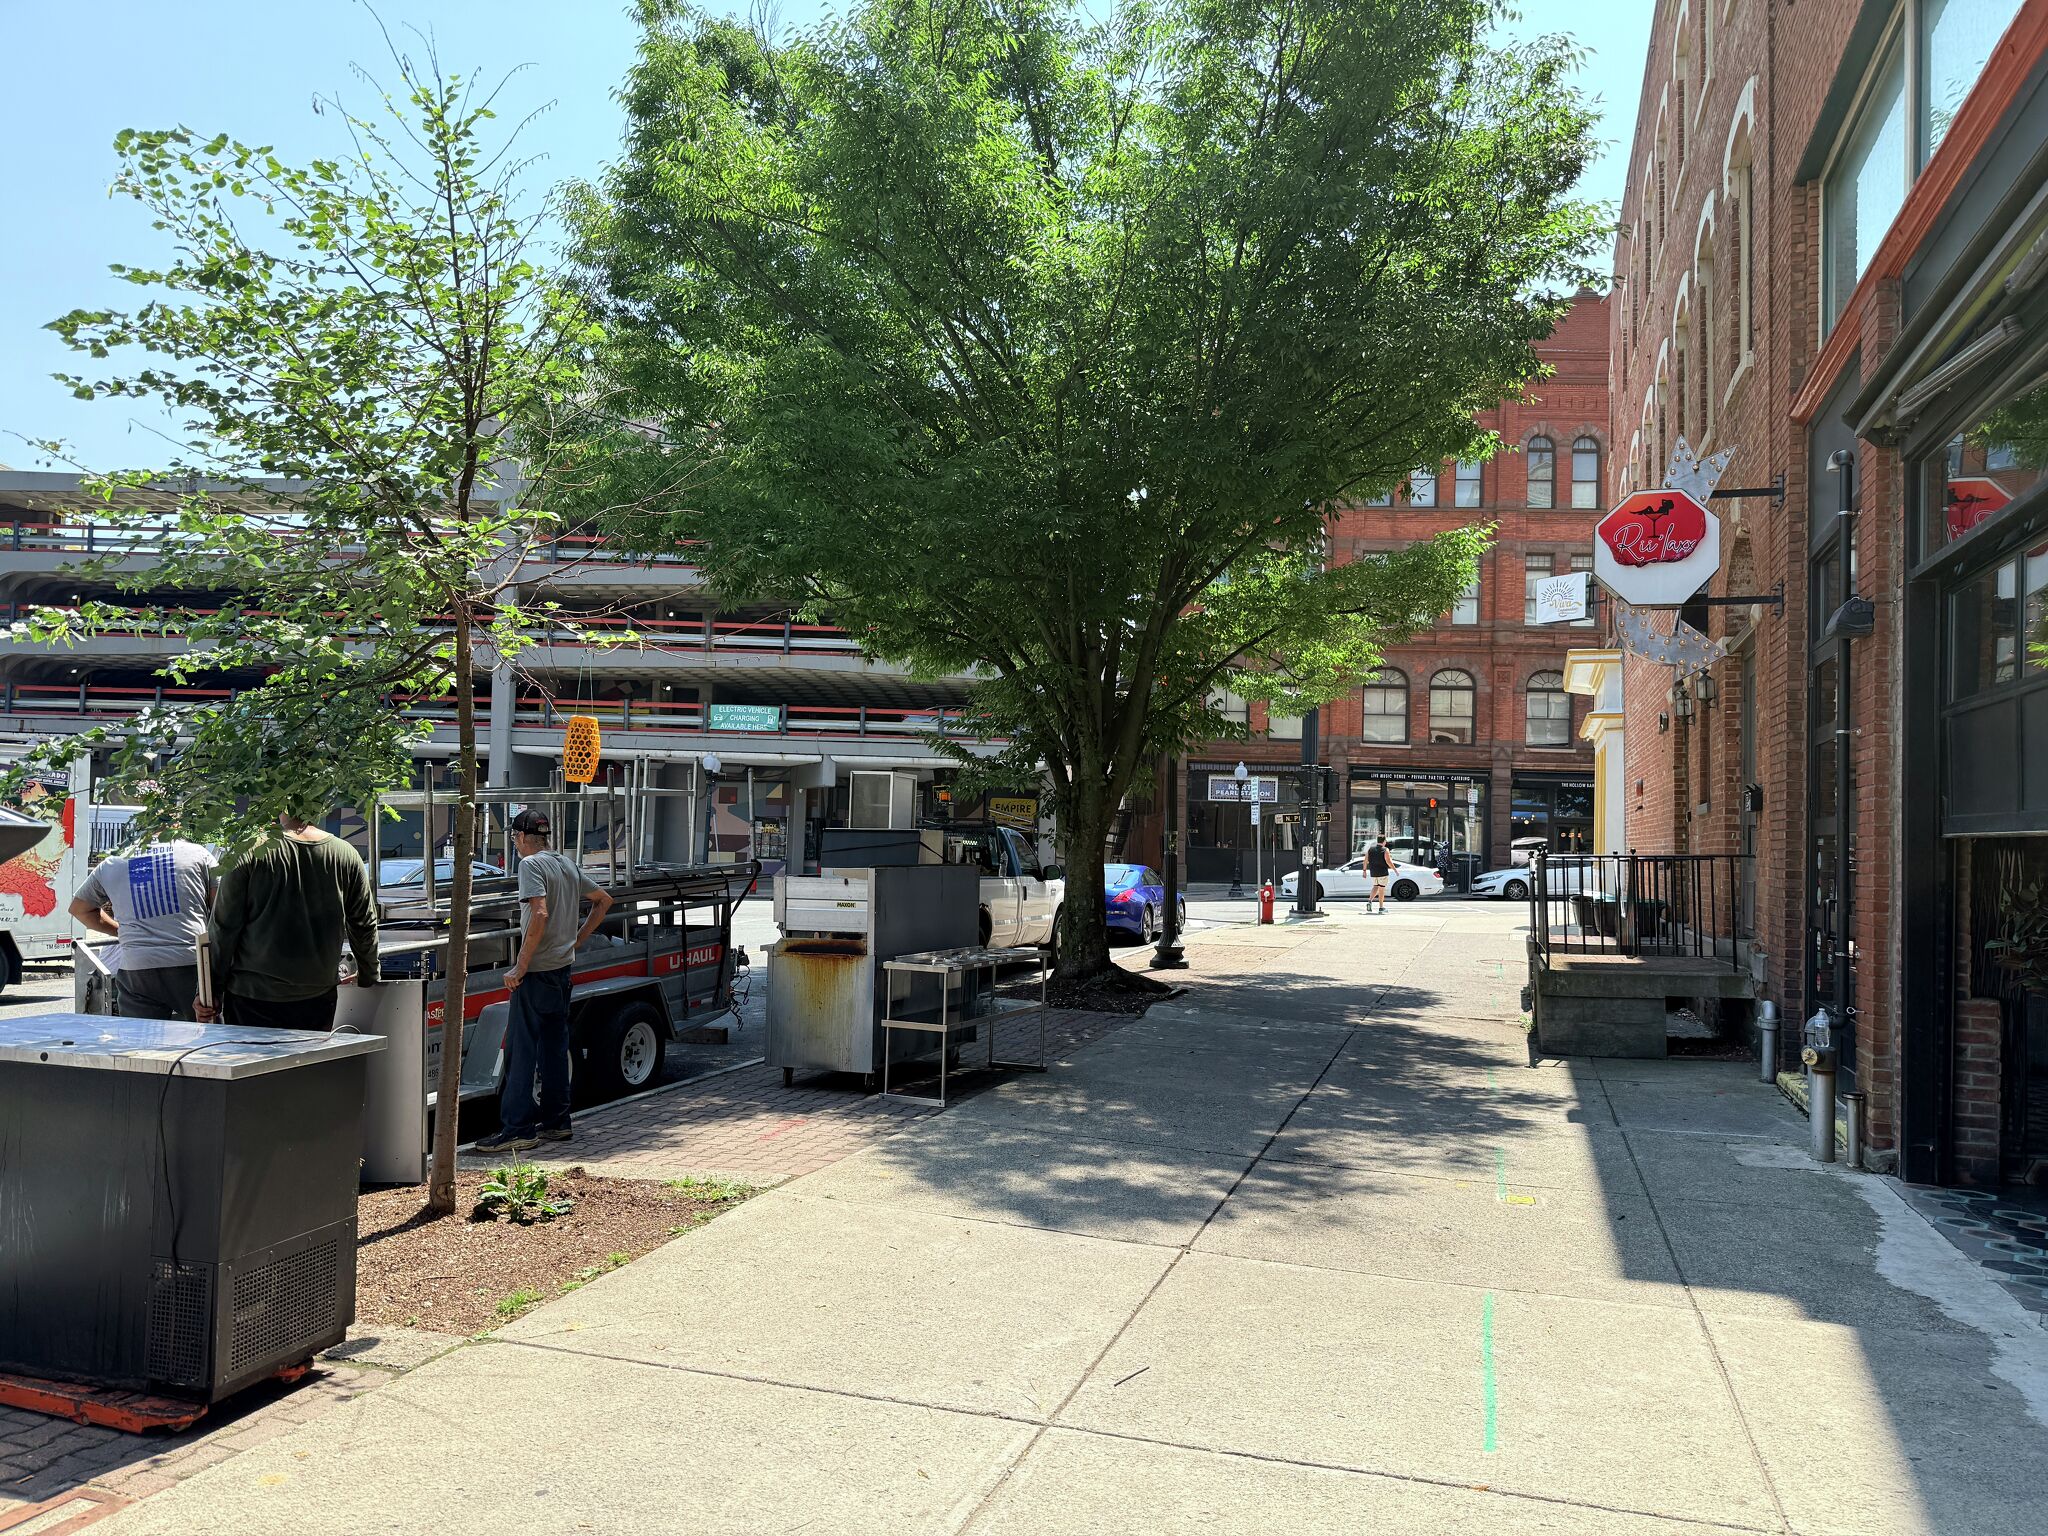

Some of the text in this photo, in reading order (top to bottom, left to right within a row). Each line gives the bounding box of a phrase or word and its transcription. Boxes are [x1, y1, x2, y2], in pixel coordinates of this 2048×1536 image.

[1550, 599, 1579, 608] Viva
[720, 722, 769, 731] AVAILABLE HERE
[995, 804, 1031, 813] EMPIRE
[669, 948, 716, 969] U-HAUL
